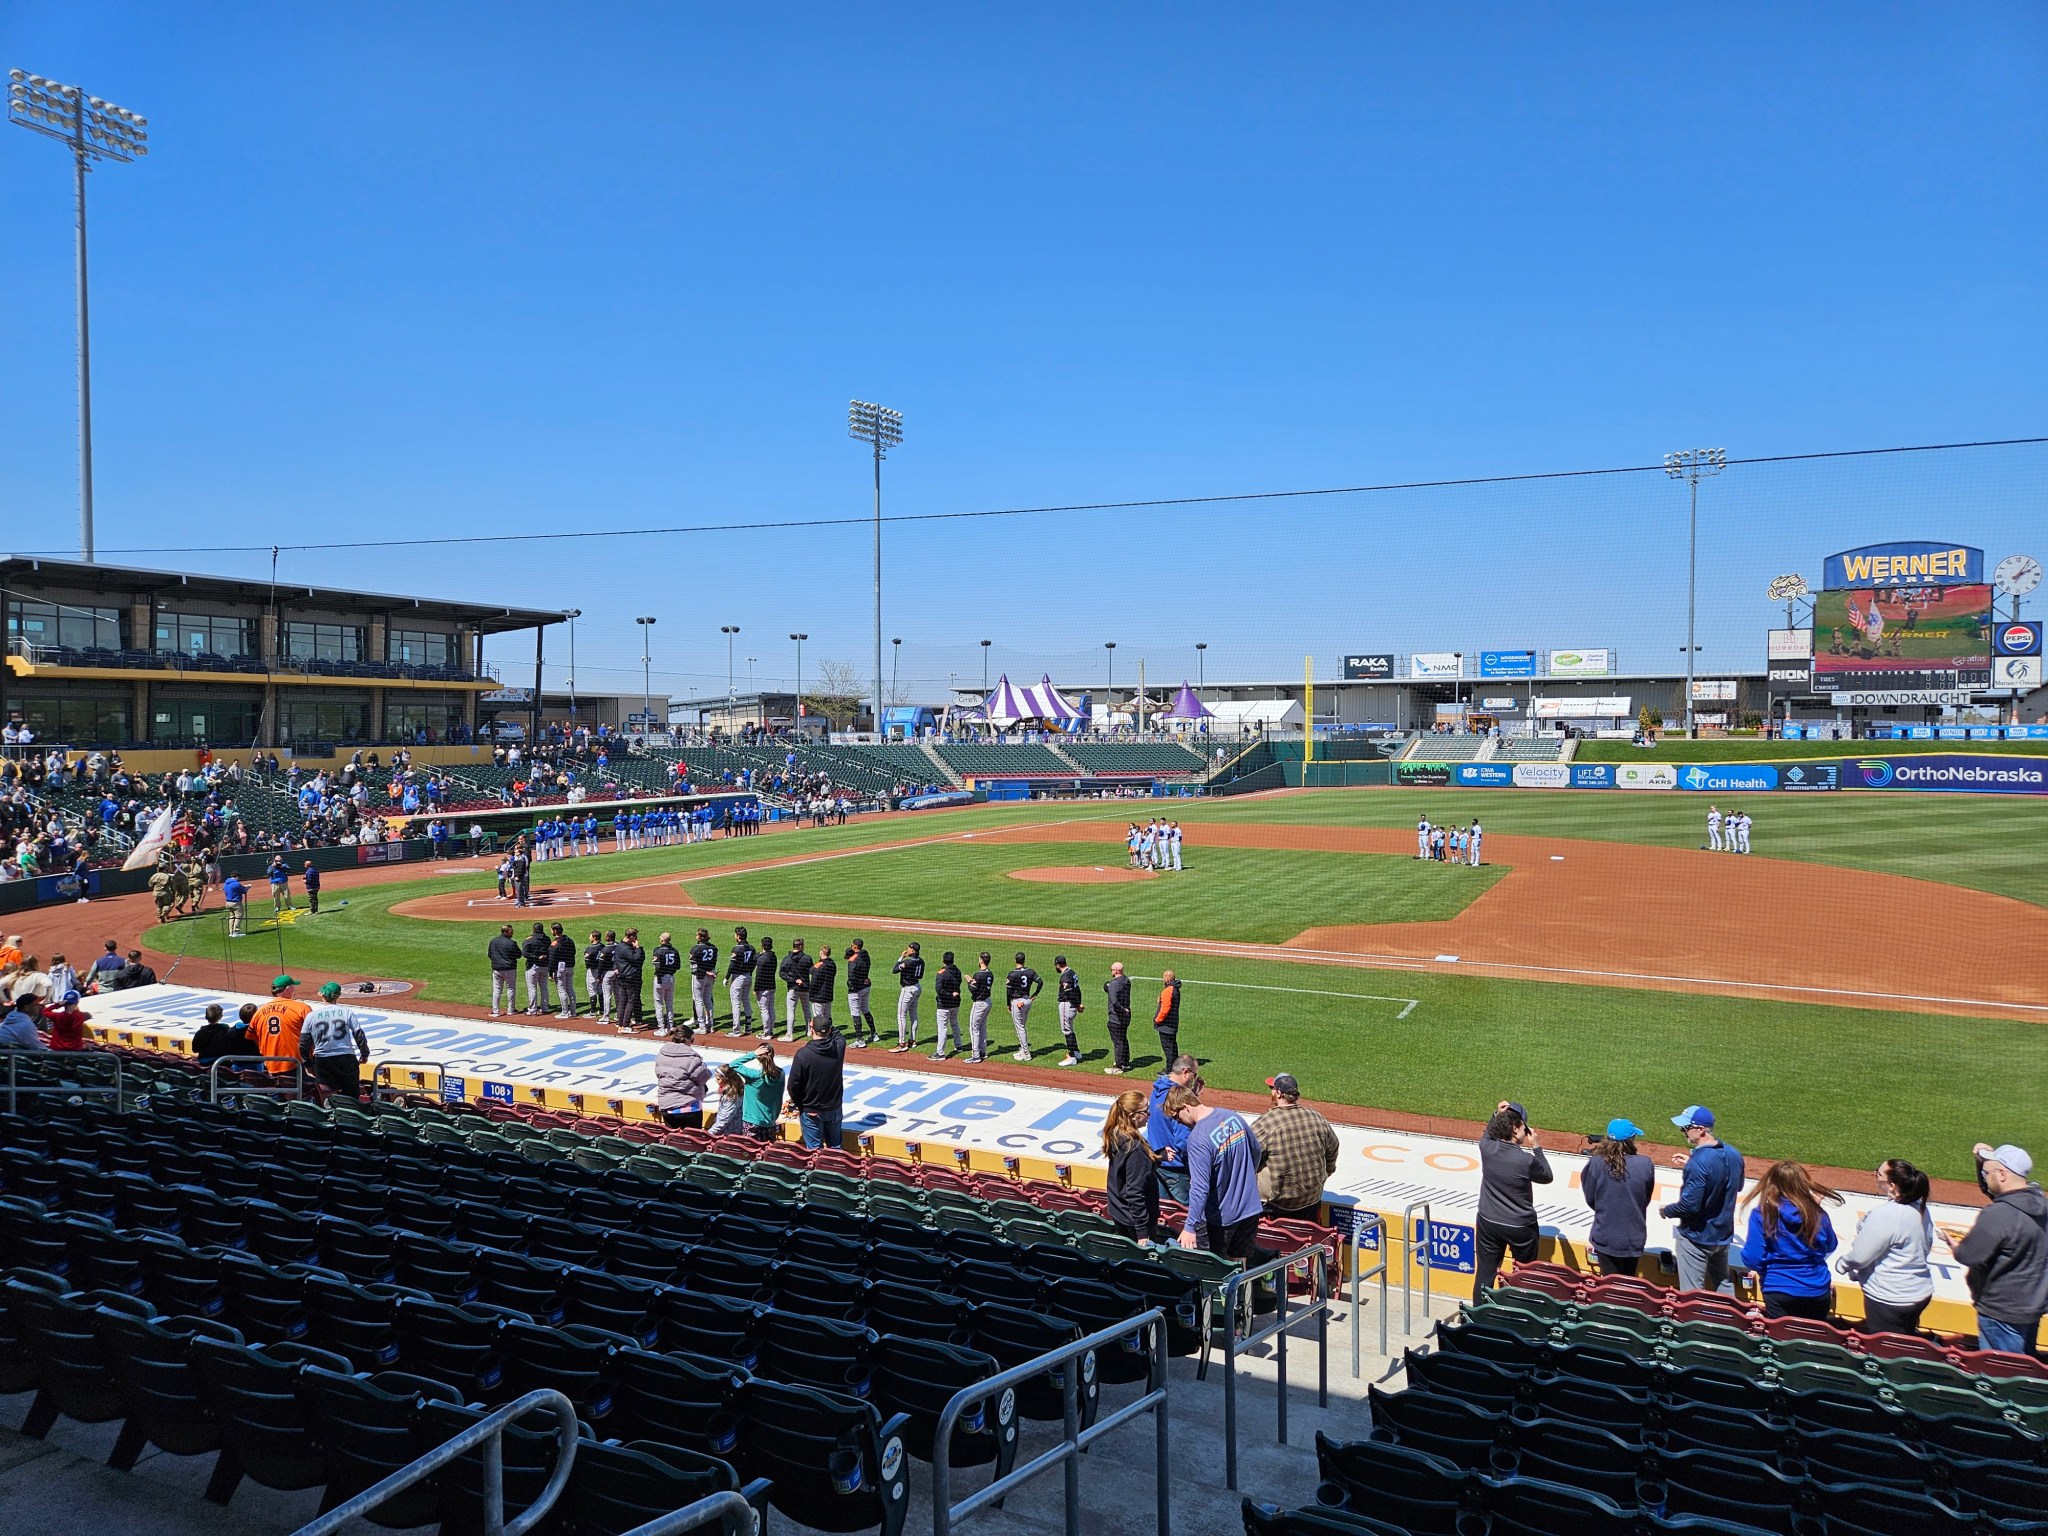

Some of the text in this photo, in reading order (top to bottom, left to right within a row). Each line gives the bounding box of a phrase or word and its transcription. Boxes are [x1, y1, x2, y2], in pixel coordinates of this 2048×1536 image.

[1843, 549, 1967, 582] WERNER
[1873, 576, 1935, 585] PARK
[1881, 630, 1950, 639] WRNER
[1349, 657, 1389, 667] RAKA
[1769, 670, 1809, 681] RION
[1854, 693, 1969, 704] DOWNDRAUGHT
[1519, 766, 1565, 779] Velocity
[1895, 766, 2042, 783] OrthoNebraska
[1708, 778, 1767, 788] CHI Health
[665, 953, 675, 965] 15
[702, 949, 714, 961] 23
[743, 951, 752, 963] 17
[914, 965, 922, 977] 11
[1020, 975, 1028, 988] 3
[261, 1004, 288, 1016] RIPKEN
[318, 1010, 343, 1019] MAYO
[268, 1016, 281, 1035] 8
[315, 1019, 348, 1043] 23
[490, 1084, 506, 1097] 108
[1357, 1211, 1377, 1219] OBJECTS
[1431, 1225, 1461, 1242] 107
[1431, 1241, 1460, 1259] 108
